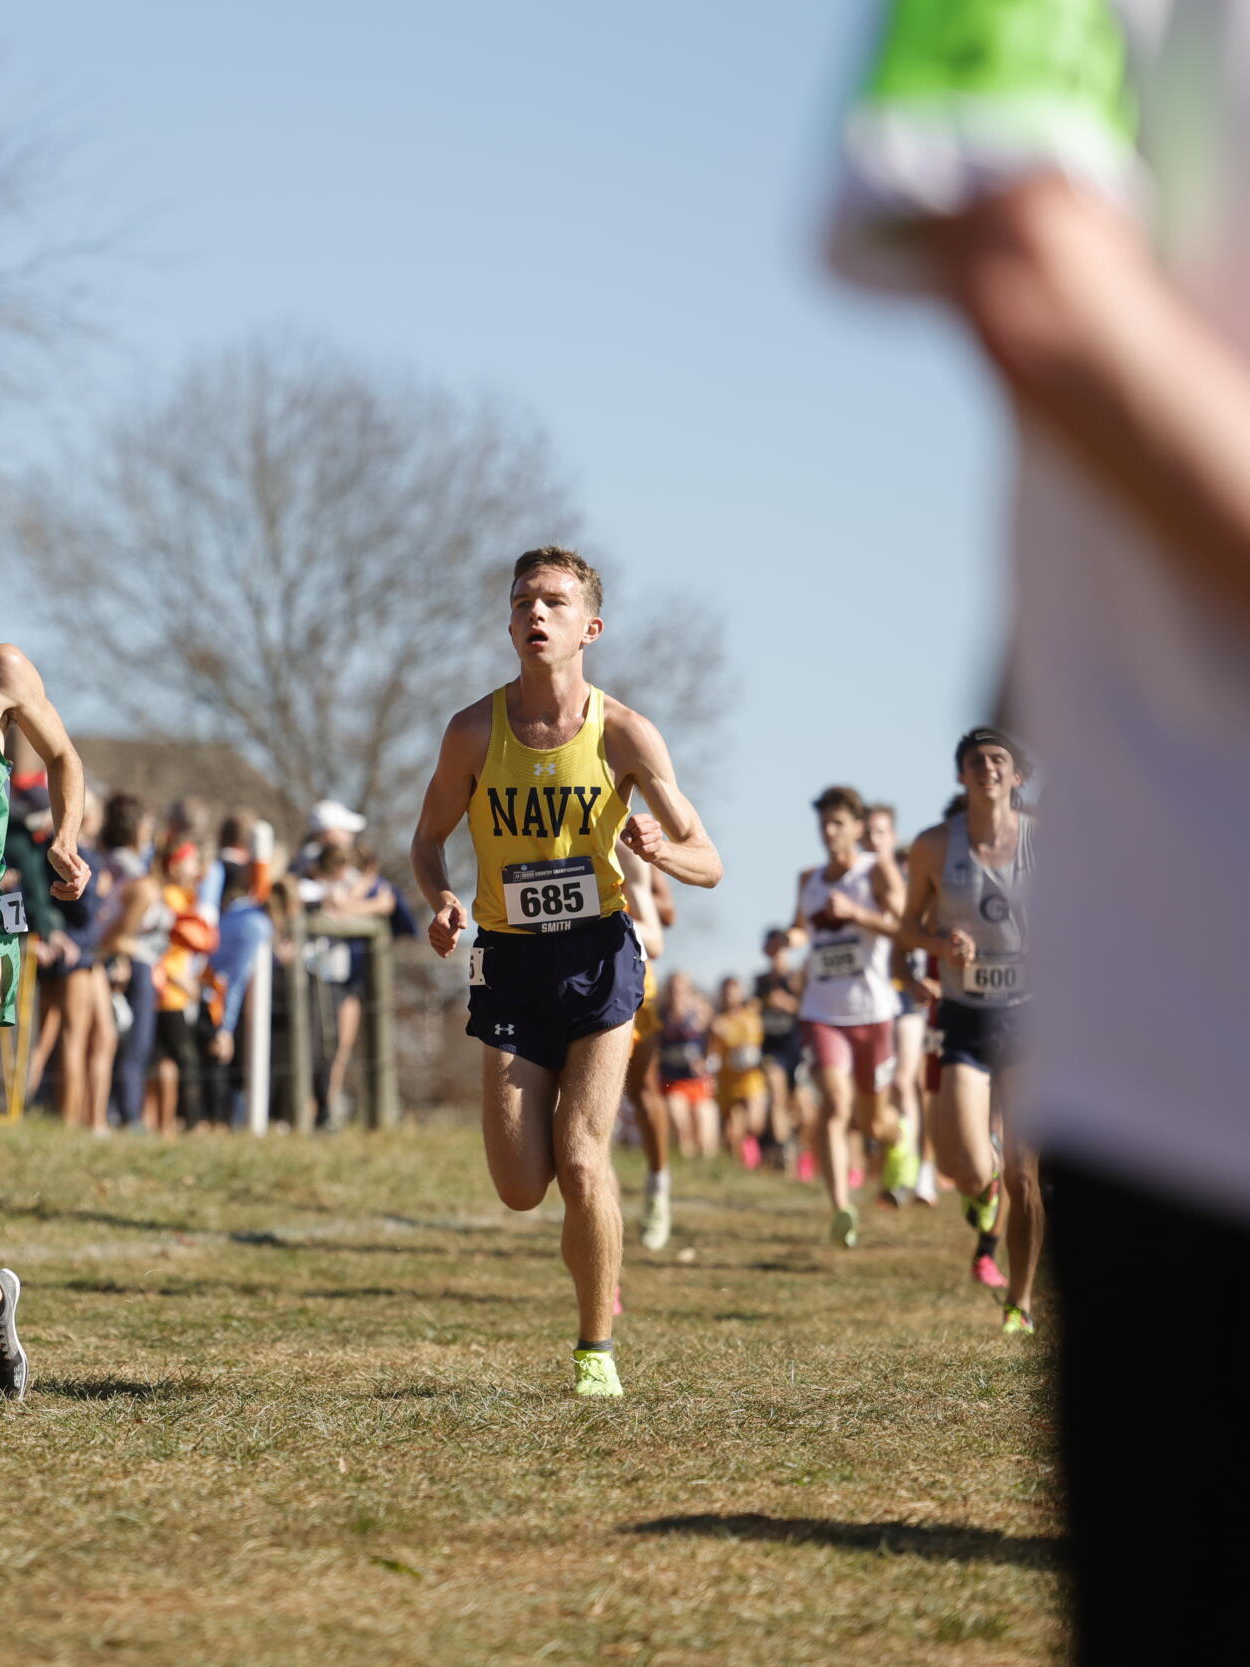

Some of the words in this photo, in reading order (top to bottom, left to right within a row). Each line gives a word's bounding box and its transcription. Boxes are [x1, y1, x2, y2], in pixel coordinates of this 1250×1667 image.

[487, 786, 602, 838] NAVY
[520, 881, 584, 918] 685
[541, 920, 572, 933] SMITH
[975, 967, 1017, 988] 600
